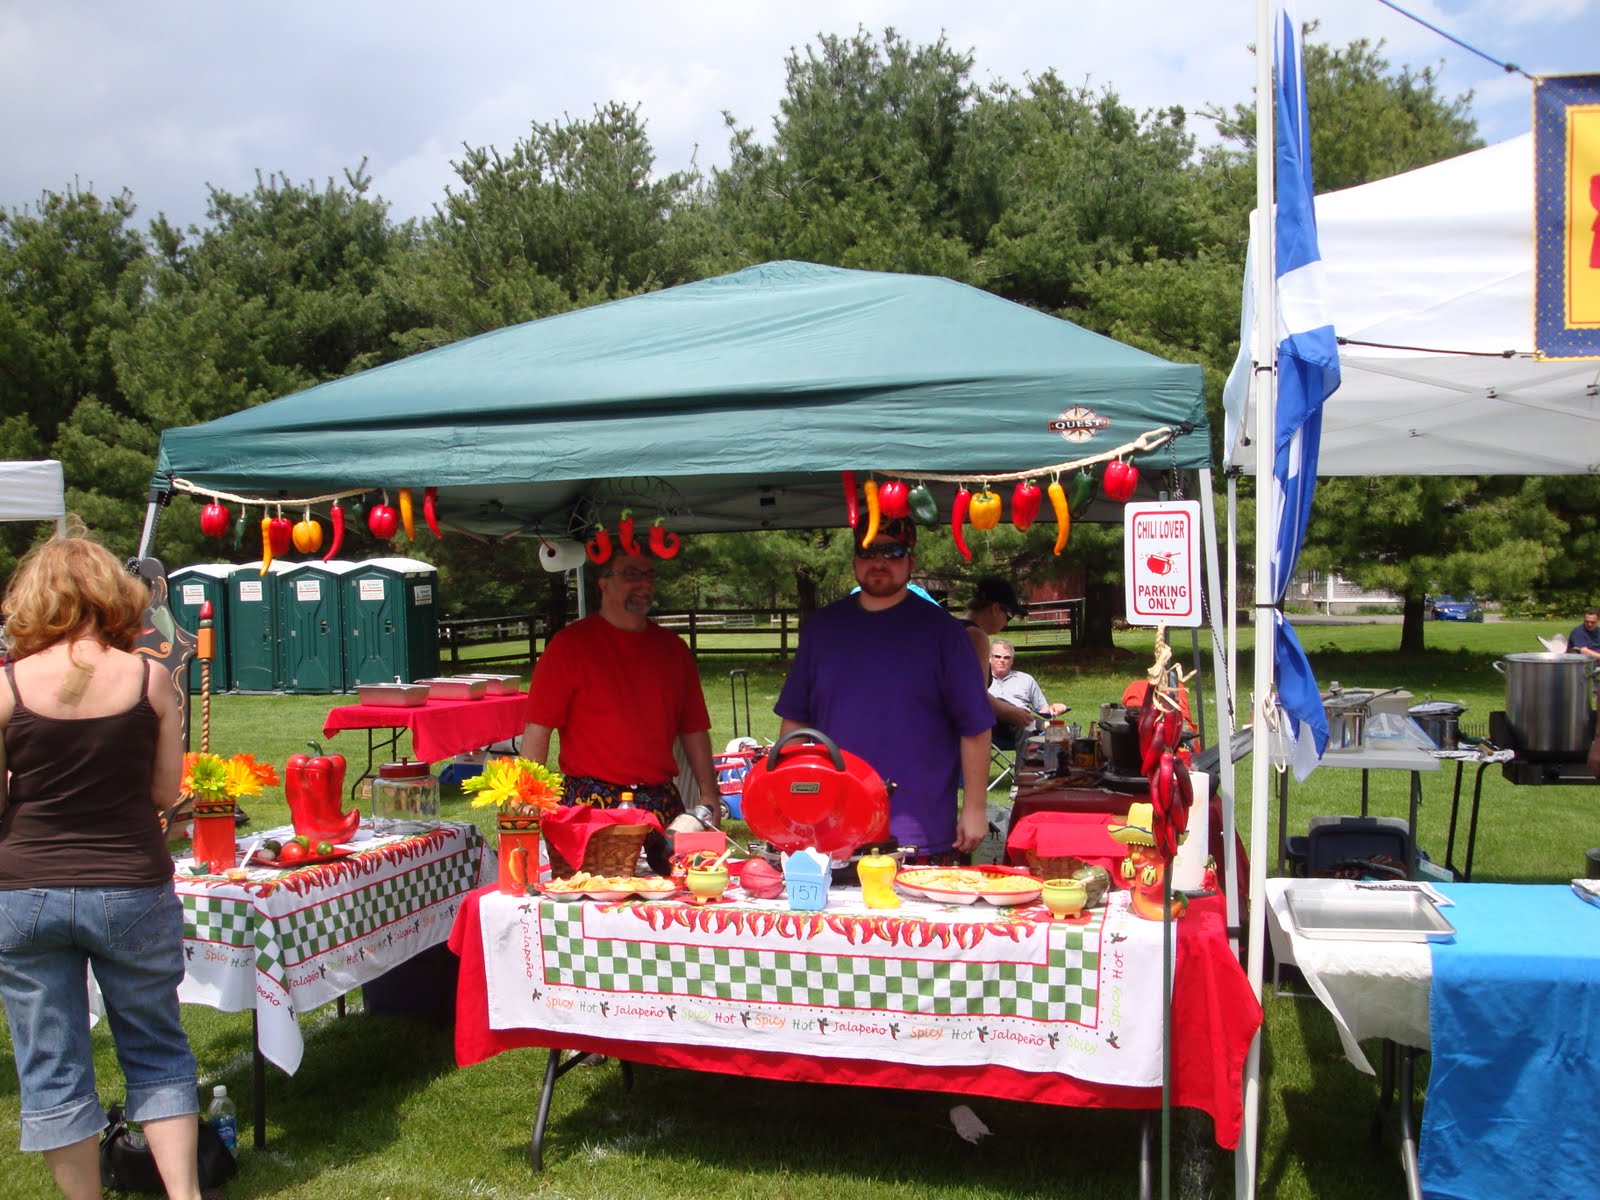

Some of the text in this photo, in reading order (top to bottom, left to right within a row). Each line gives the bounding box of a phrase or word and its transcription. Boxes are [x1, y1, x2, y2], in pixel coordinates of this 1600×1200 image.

[1055, 419, 1101, 430] QUEST
[1137, 520, 1185, 539] CHILI LOVER
[1138, 585, 1187, 598] PARKING
[1148, 597, 1177, 610] ONLY
[792, 885, 818, 901] 157
[203, 950, 230, 964] Spicy
[520, 919, 534, 979] Jalapeño
[1112, 949, 1124, 980] Hot
[545, 996, 574, 1011] Spicy
[580, 1001, 599, 1014] Hot
[613, 1004, 666, 1019] Jalapeño
[715, 1012, 737, 1025] Hot
[755, 1013, 786, 1031] Spicy
[792, 1018, 816, 1032] Hot
[832, 1020, 888, 1036] Jalapeño
[909, 1025, 943, 1041] Spicy
[951, 1028, 975, 1041] Hot
[990, 1029, 1046, 1047] Jalapeño
